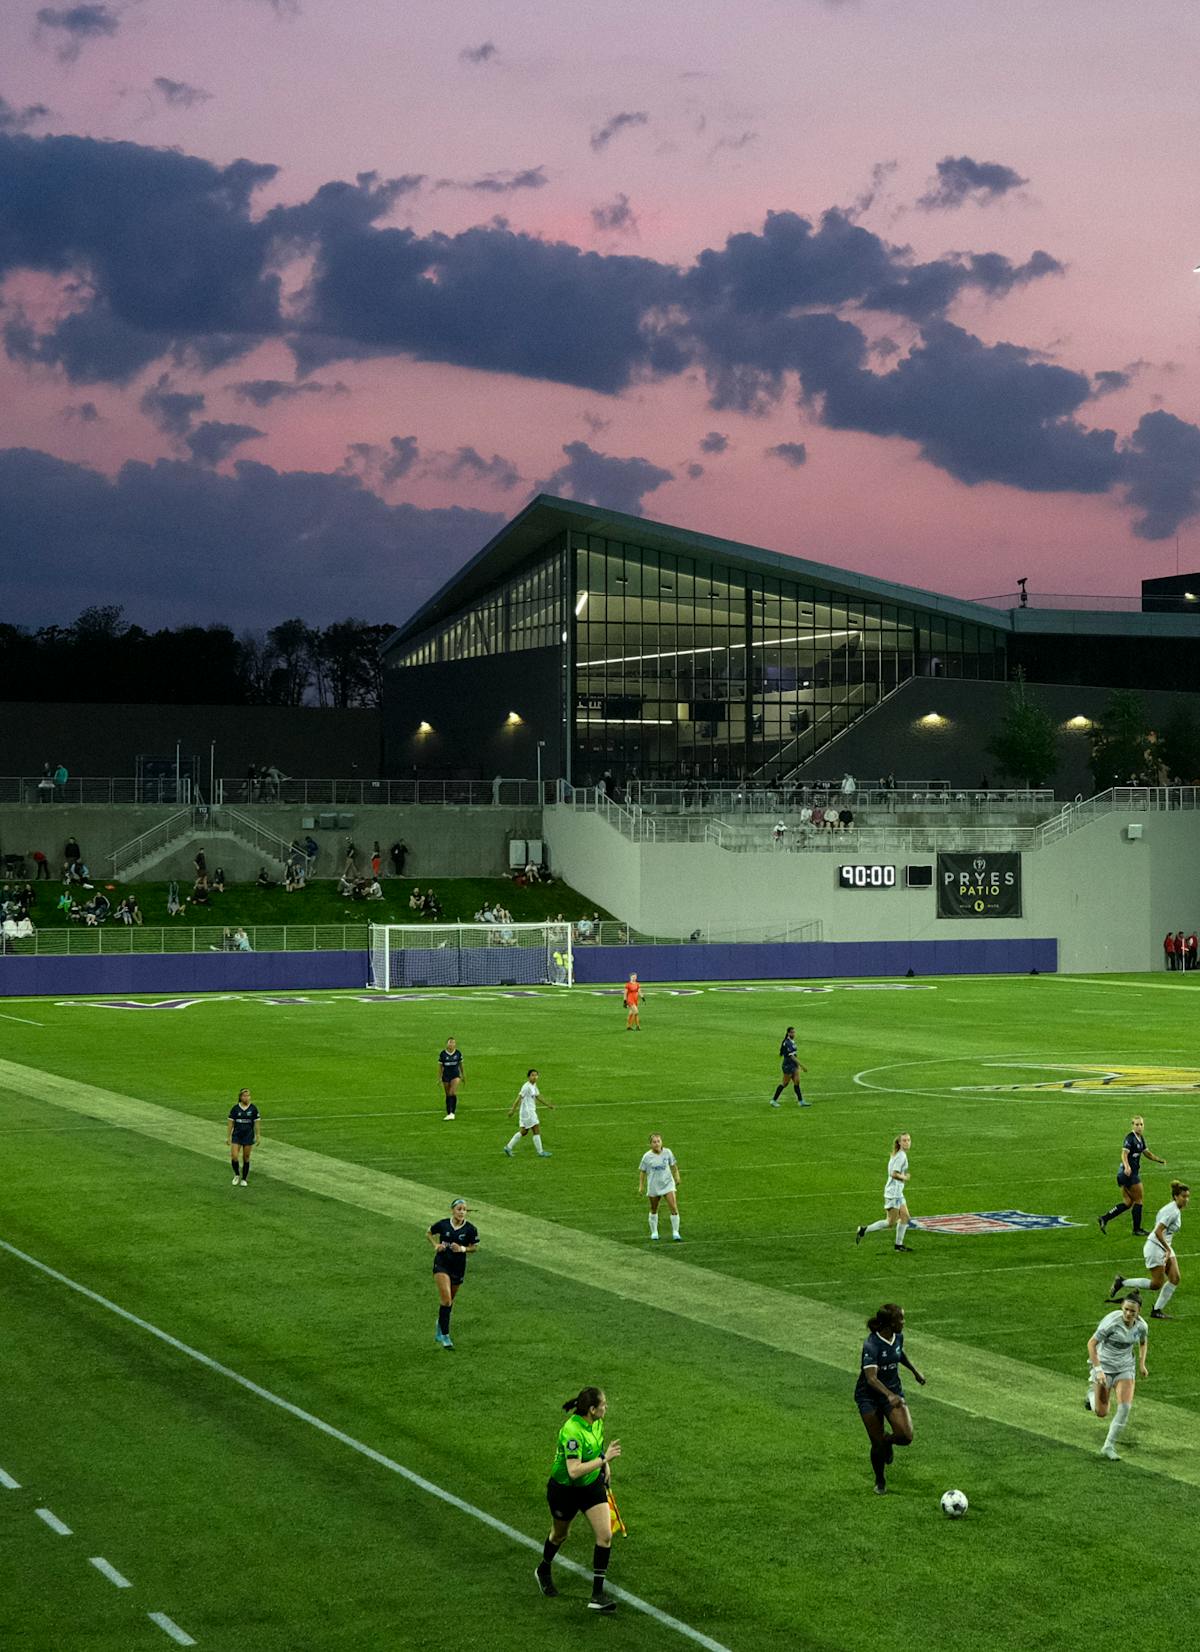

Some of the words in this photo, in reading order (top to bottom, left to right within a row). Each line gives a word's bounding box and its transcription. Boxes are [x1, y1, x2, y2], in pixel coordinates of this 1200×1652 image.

[842, 866, 895, 886] 90:00
[944, 872, 1014, 885] PRYES
[960, 886, 1000, 896] PATIO
